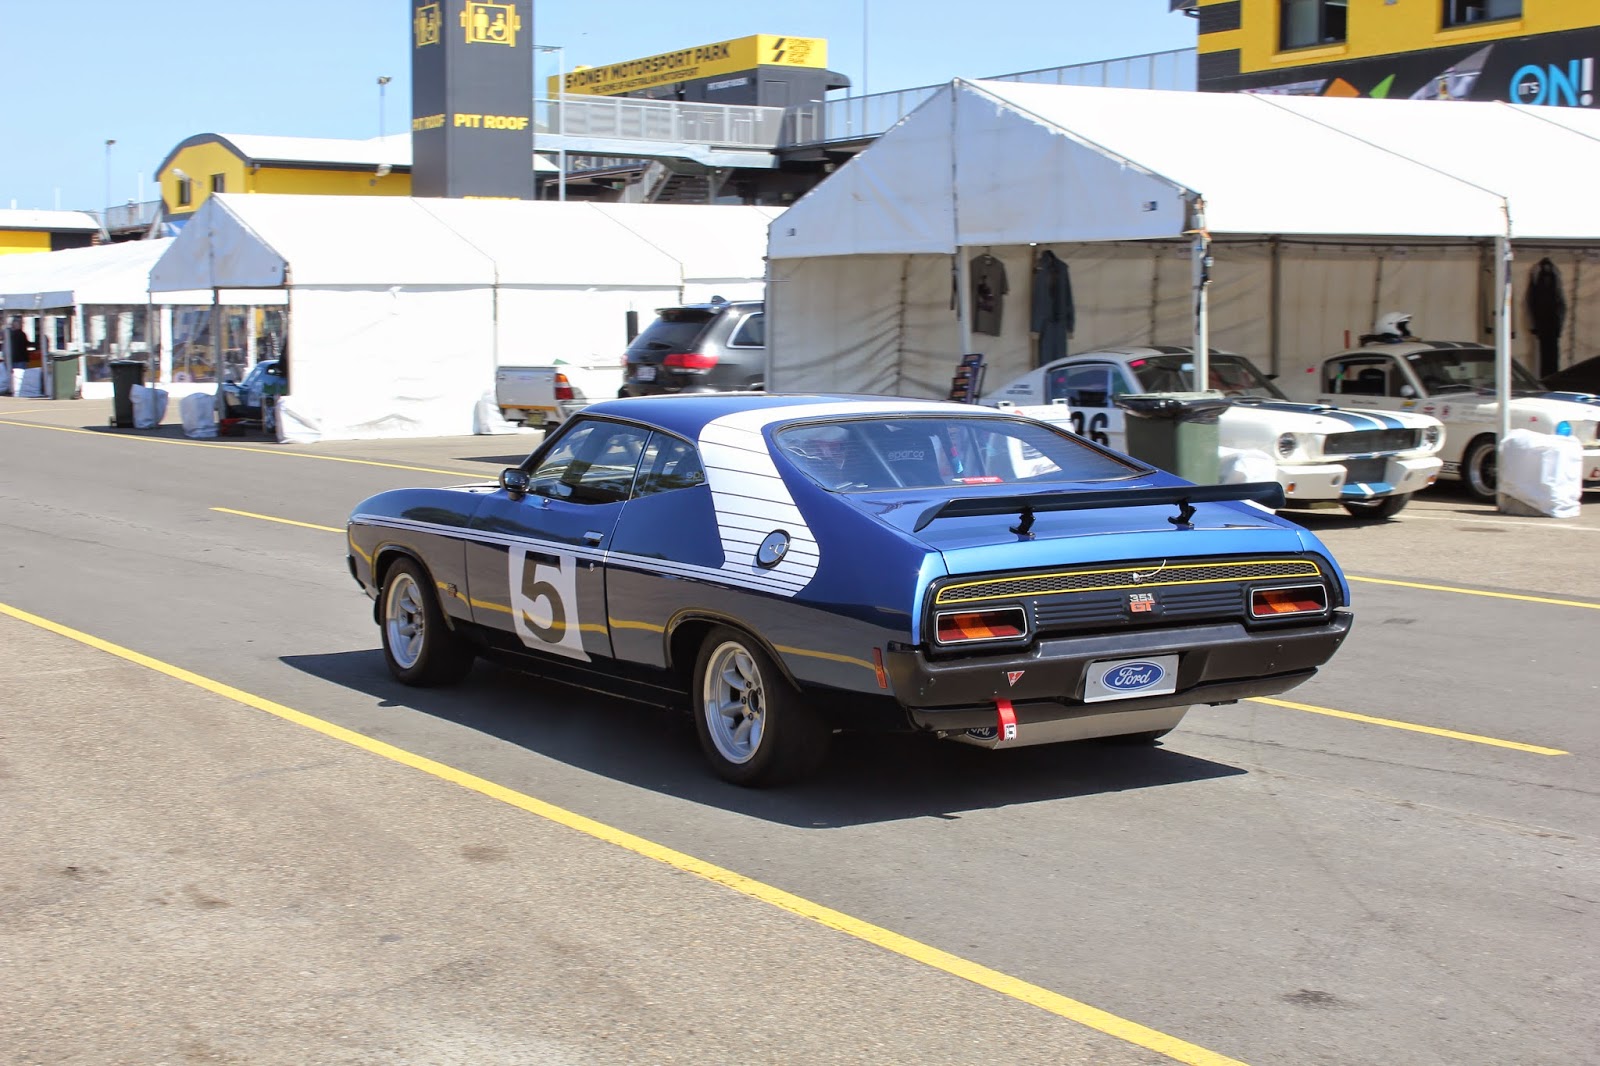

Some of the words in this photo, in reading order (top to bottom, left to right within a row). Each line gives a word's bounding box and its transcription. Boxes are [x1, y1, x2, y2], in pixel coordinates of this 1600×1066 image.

[565, 69, 608, 89] SYDNEY
[611, 50, 691, 79] MOTORSPORT
[695, 43, 730, 64] PARK
[1509, 57, 1594, 106] ON!
[454, 114, 482, 127] PIT
[483, 115, 529, 130] ROOF
[521, 550, 566, 643] 5
[1129, 593, 1155, 604] 351
[1130, 601, 1153, 613] GT
[1114, 666, 1152, 686] Ford
